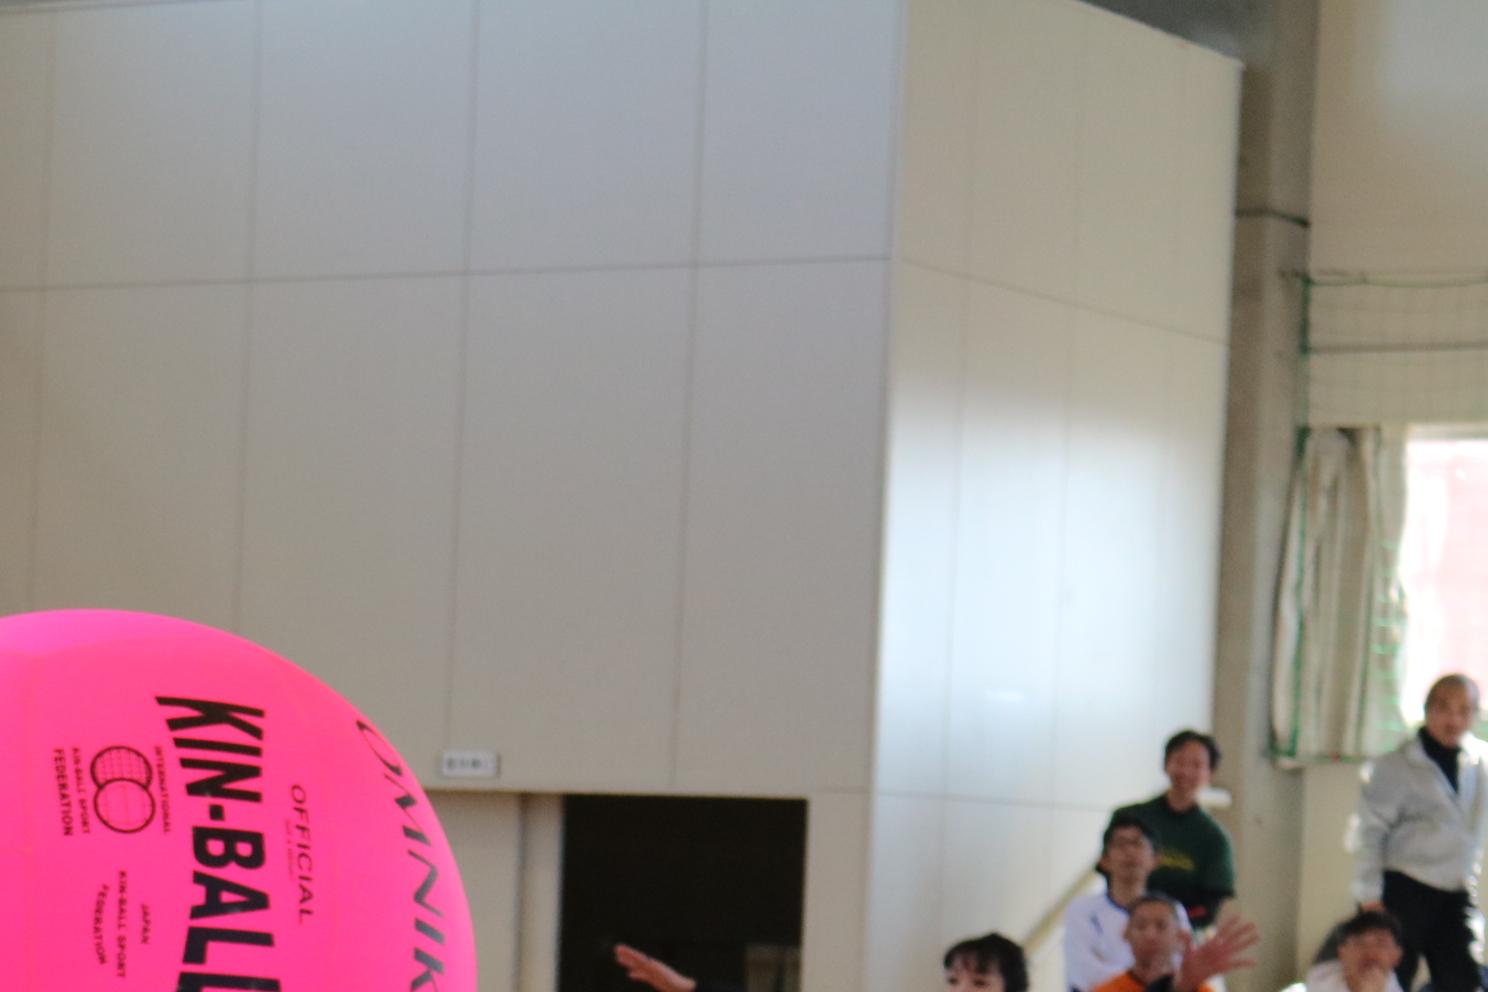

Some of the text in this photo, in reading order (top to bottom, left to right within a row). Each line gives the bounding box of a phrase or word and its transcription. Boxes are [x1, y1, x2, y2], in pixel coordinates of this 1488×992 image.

[53, 748, 73, 836] FEDERATION
[79, 798, 90, 834] SPORT
[154, 745, 172, 833] INTERNATIONAL
[291, 784, 314, 924] OFFICIAL
[93, 883, 110, 965] FEDERATION
[116, 870, 127, 978] KIN-BALL SPORT
[140, 903, 151, 945] JAPAN
